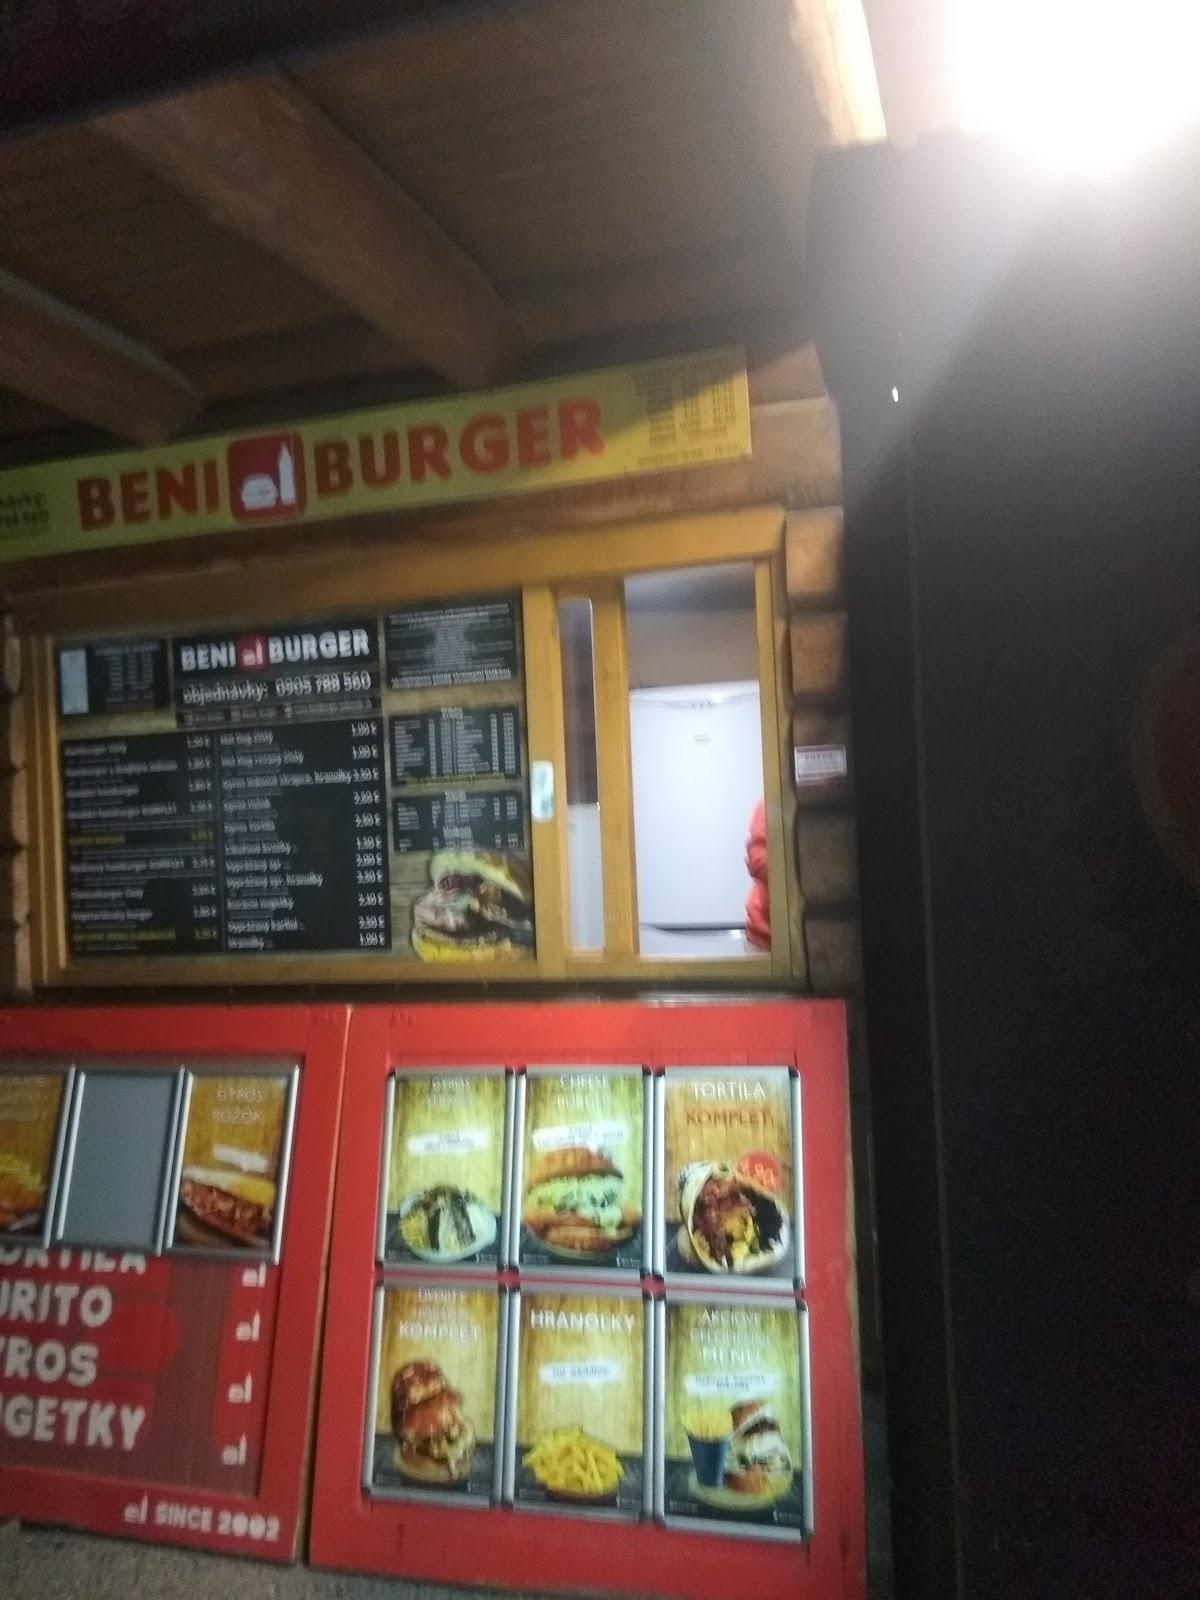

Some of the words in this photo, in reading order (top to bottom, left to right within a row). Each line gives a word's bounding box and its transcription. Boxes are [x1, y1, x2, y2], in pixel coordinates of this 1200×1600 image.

[76, 459, 219, 531] BENI
[311, 397, 608, 498] BURGER
[181, 641, 237, 672] BENI
[268, 628, 370, 665] BURGER
[344, 671, 371, 692] 560
[690, 1081, 766, 1100] TORTILA
[686, 1107, 774, 1128] KOMPLET
[531, 1308, 635, 1332] HRANOLKY
[155, 1500, 214, 1534] SINCE
